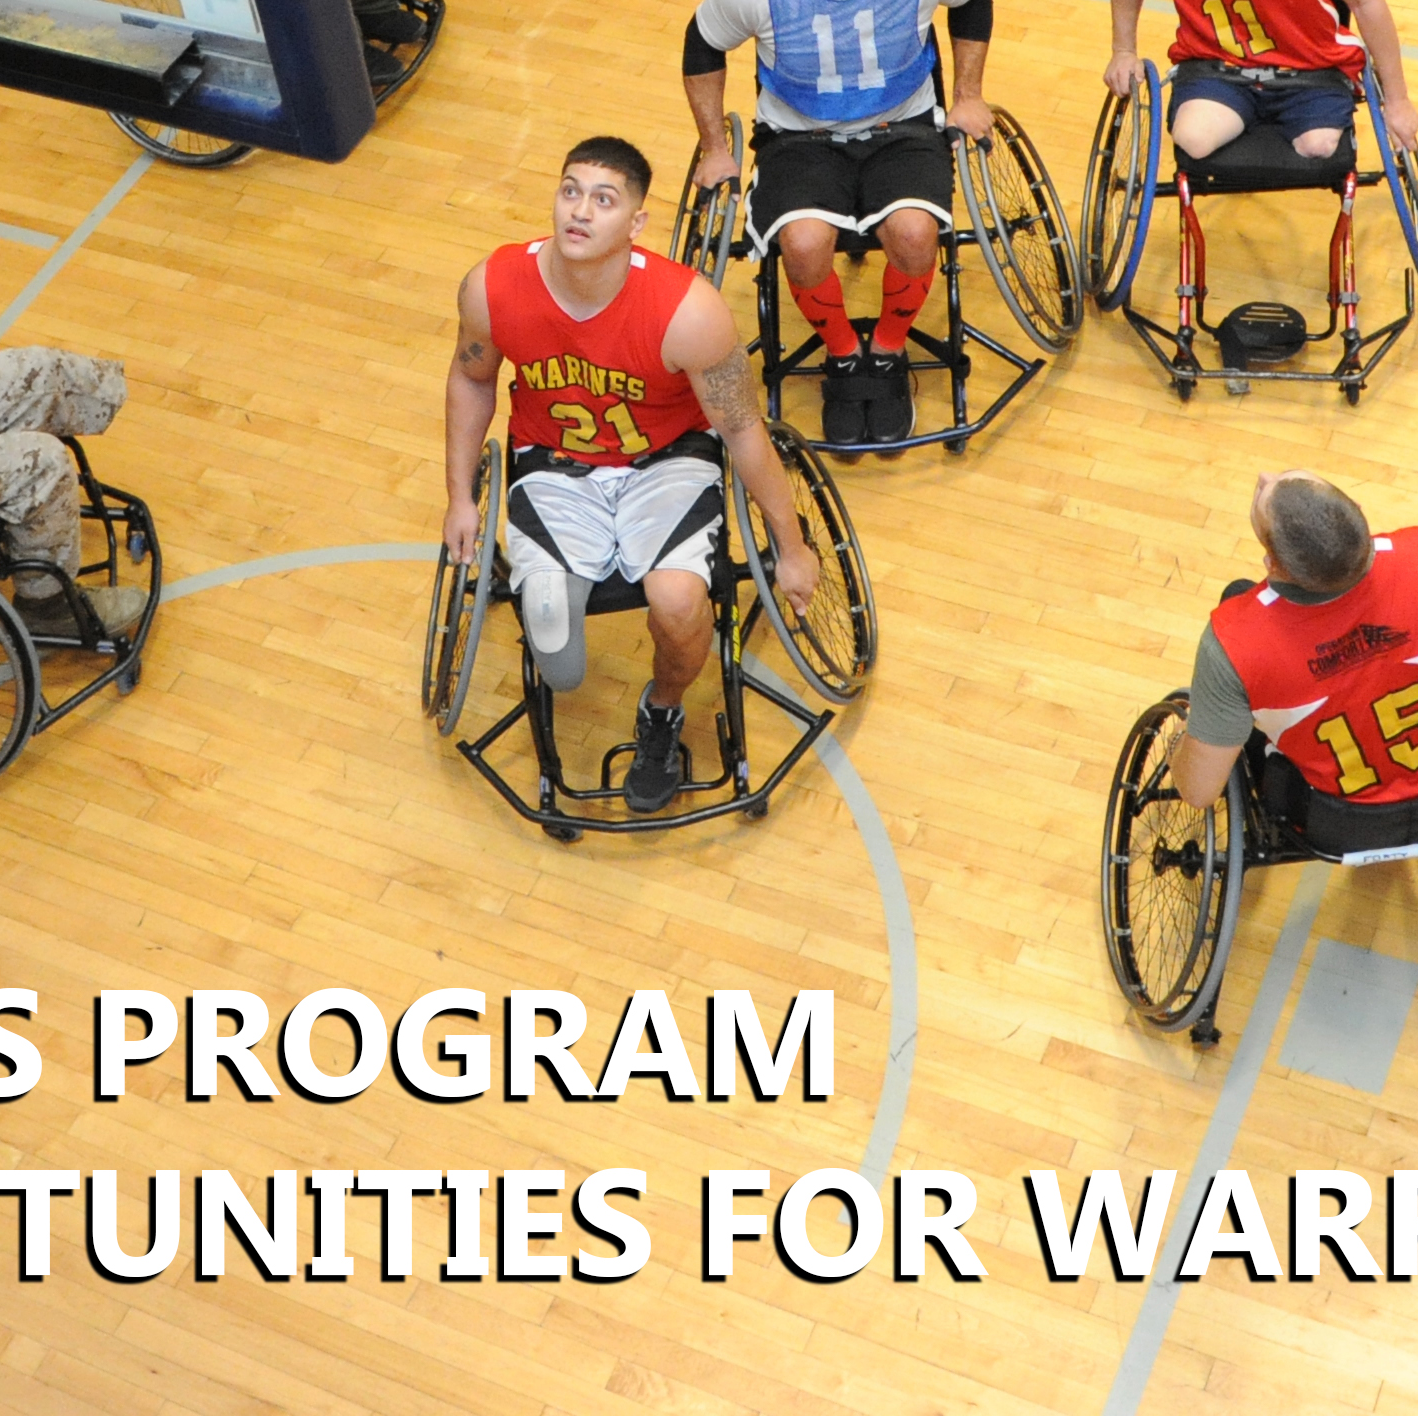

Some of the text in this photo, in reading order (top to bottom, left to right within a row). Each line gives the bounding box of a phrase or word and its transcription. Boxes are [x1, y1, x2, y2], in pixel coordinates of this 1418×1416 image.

[811, 8, 887, 94] 11
[520, 353, 646, 402] MARINES
[549, 400, 652, 456] 21
